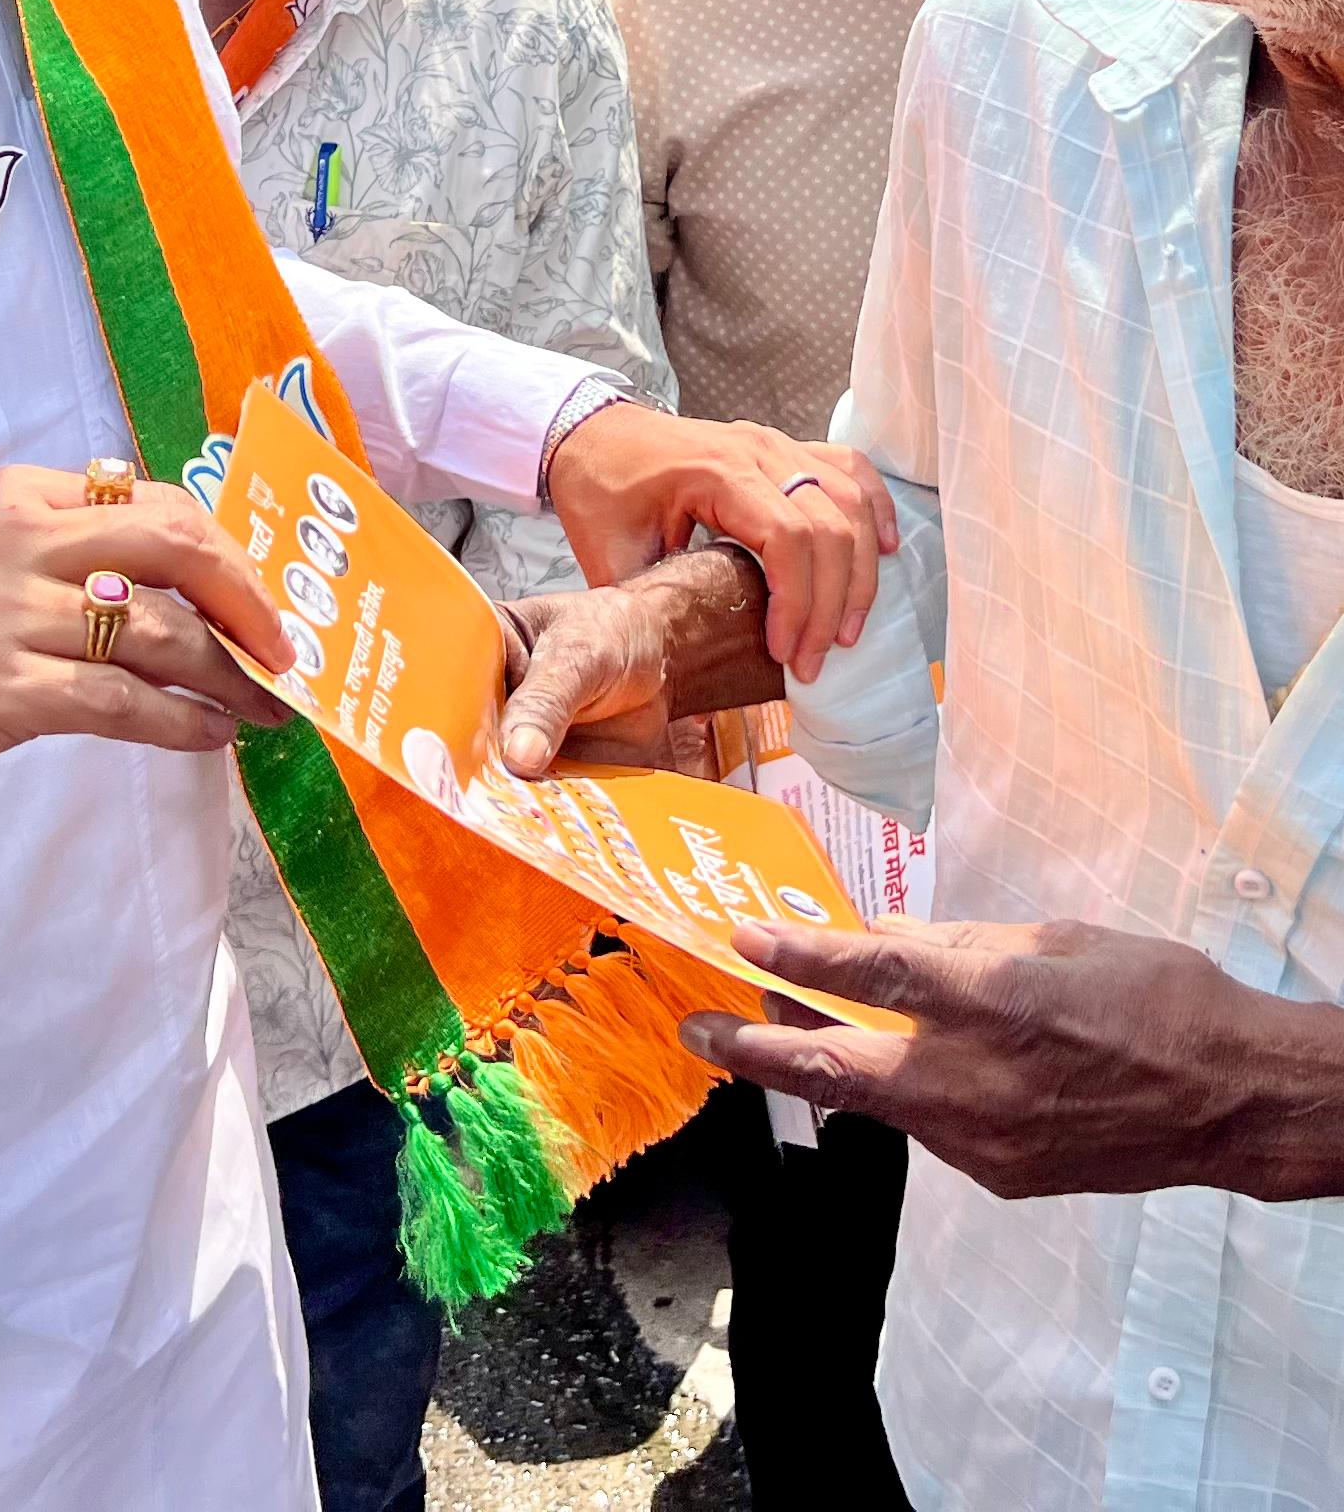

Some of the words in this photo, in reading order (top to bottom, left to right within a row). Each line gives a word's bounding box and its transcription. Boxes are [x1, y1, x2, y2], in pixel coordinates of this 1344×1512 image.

[247, 510, 274, 561] पार्टी
[345, 622, 374, 692] राष्ट्रवादी
[376, 628, 405, 691] महायुती
[882, 815, 899, 852] राव
